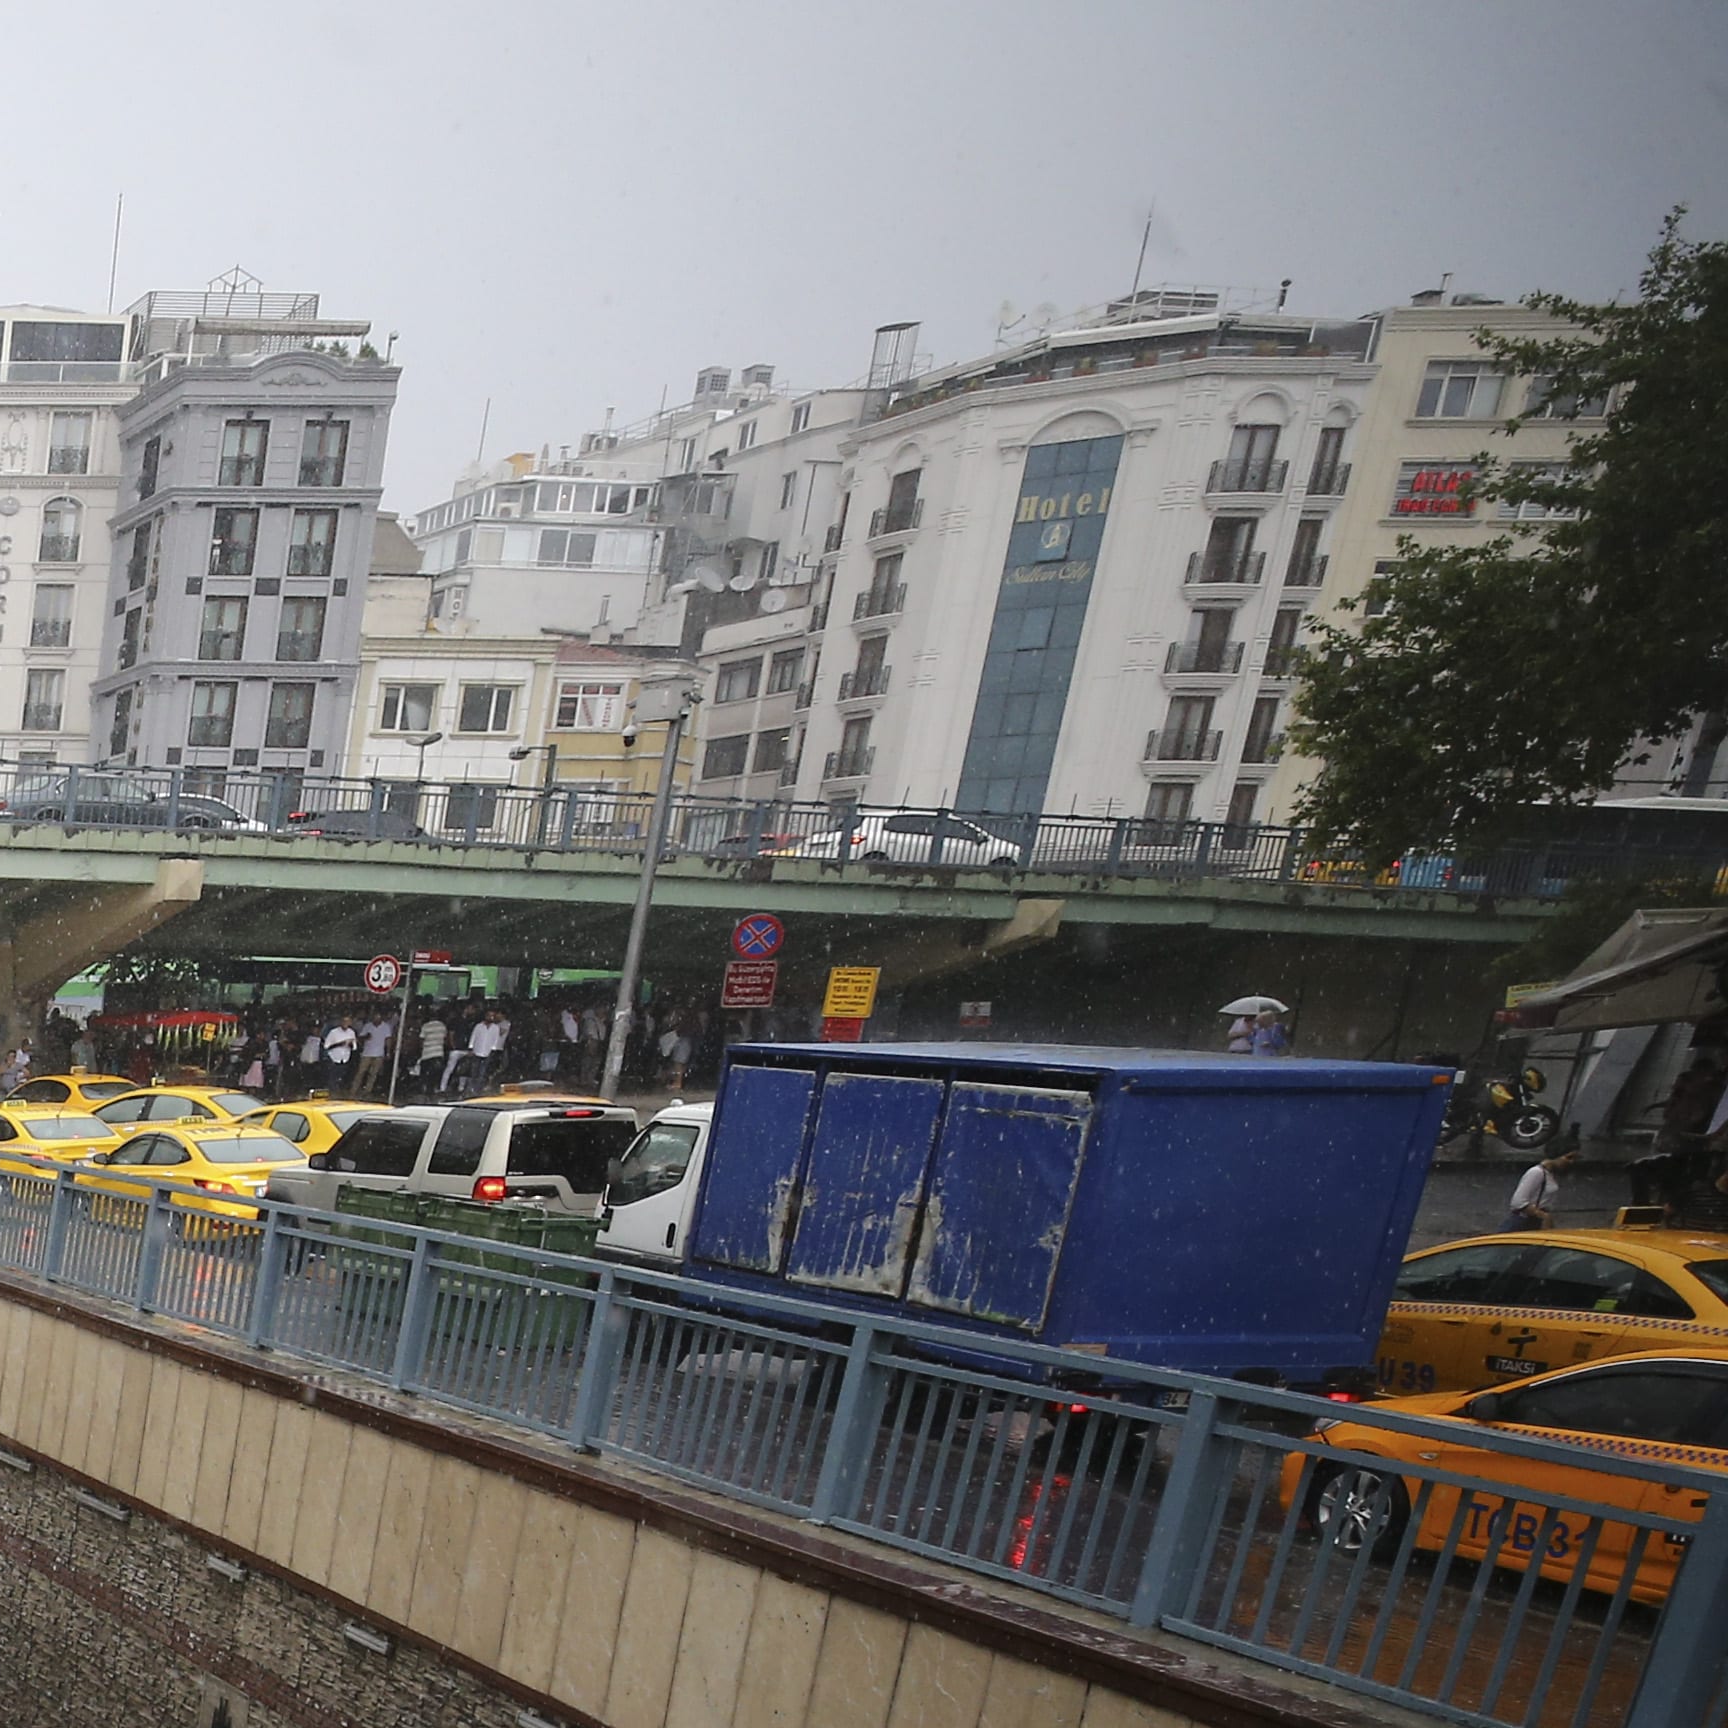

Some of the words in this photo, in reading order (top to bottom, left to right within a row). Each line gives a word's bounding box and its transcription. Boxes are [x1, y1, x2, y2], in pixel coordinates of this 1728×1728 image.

[1016, 488, 1112, 522] Hotel
[1058, 560, 1092, 584] City
[372, 965, 382, 982] 3
[1400, 1361, 1436, 1393] 39
